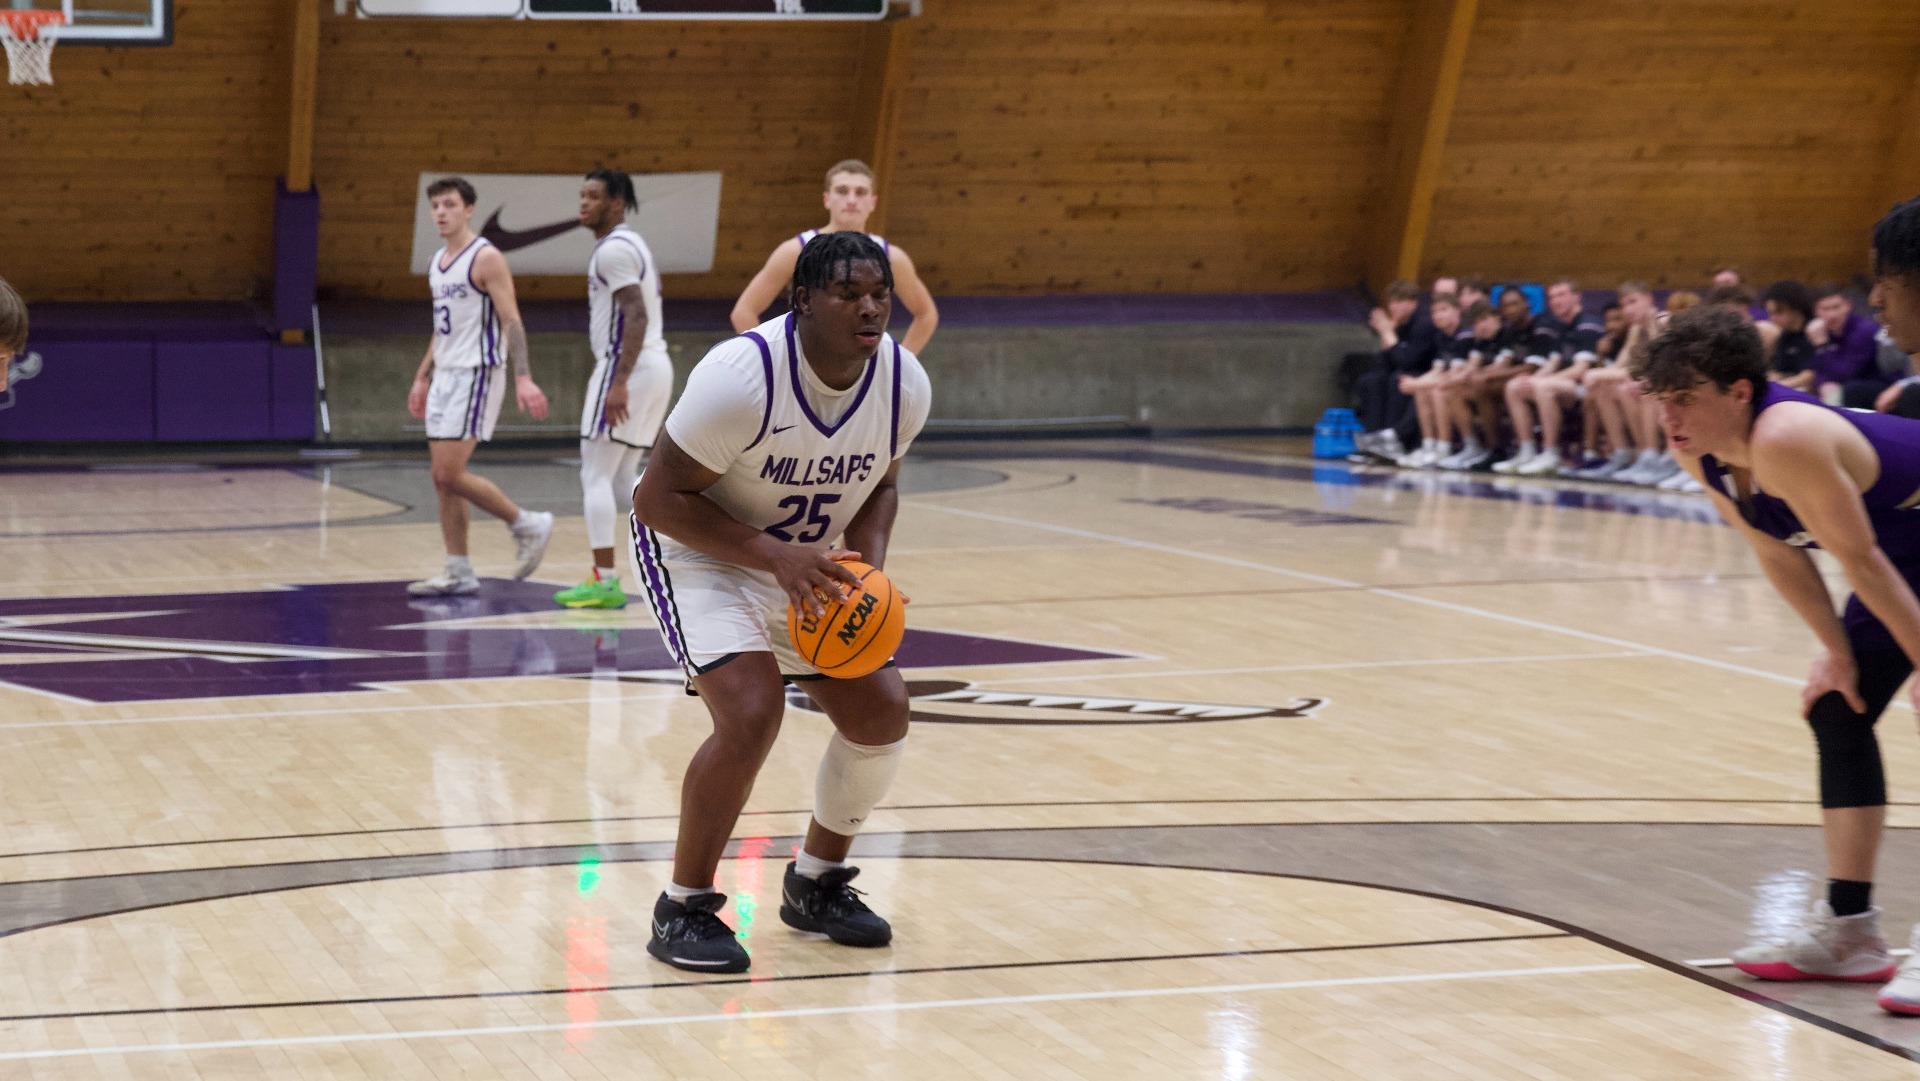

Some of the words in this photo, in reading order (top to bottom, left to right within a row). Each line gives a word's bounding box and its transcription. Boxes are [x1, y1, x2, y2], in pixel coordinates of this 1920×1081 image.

[760, 453, 876, 486] MILLSAPS
[764, 493, 842, 543] 25
[837, 592, 878, 646] NCAA
